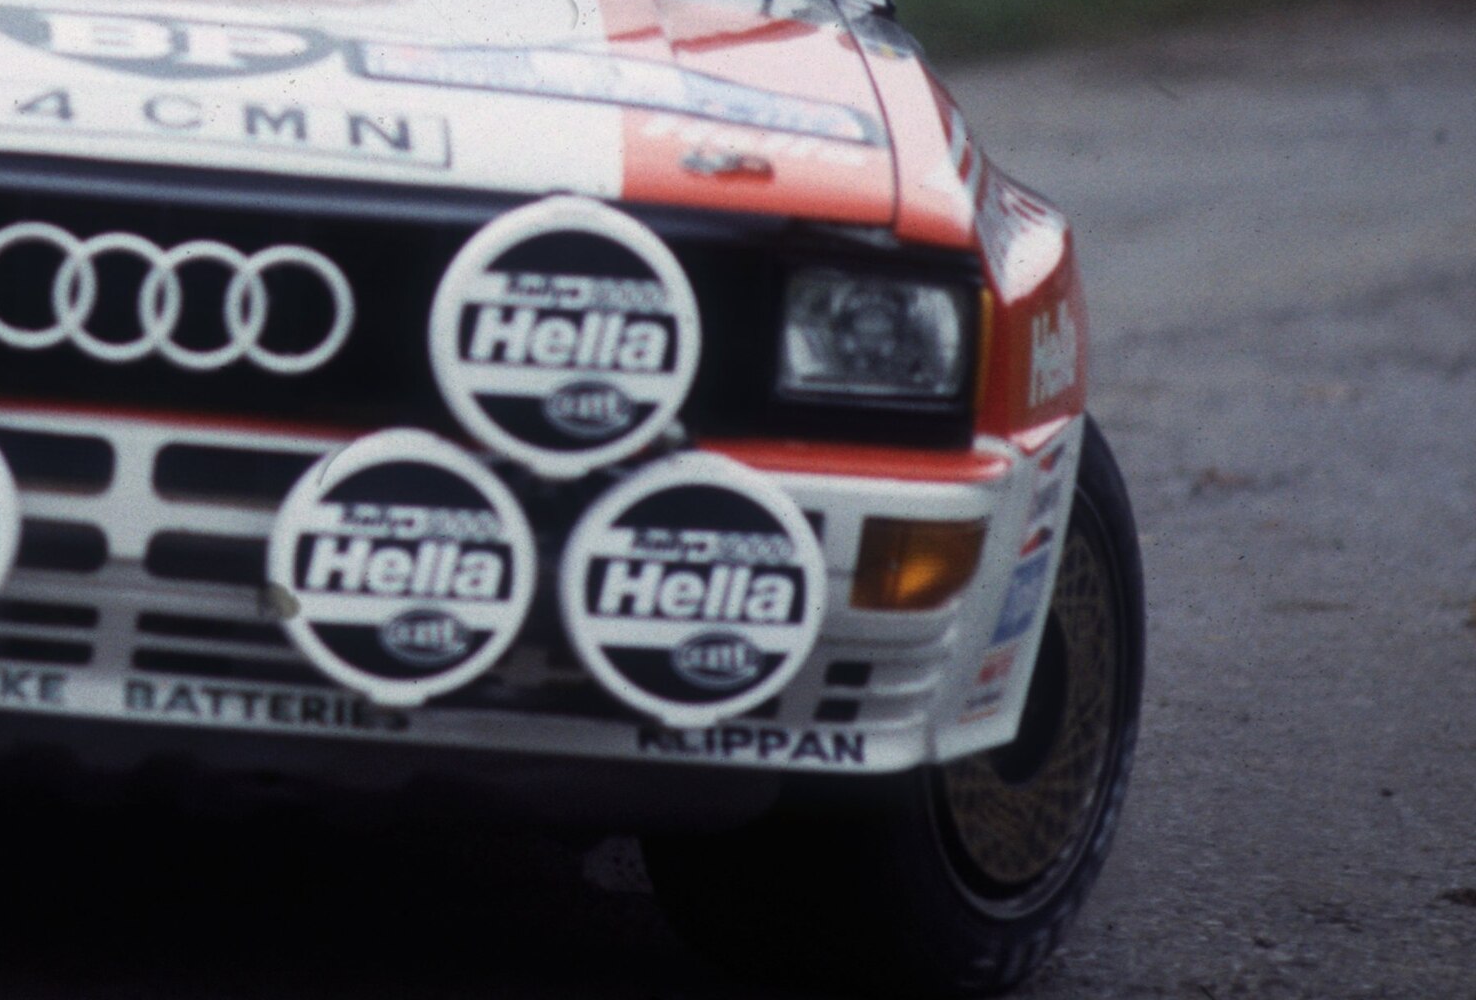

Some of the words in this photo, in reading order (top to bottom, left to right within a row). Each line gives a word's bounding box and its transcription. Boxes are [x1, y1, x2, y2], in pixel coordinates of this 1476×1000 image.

[42, 8, 311, 68] BP
[468, 307, 669, 371] Hella
[304, 534, 504, 599] Hella
[597, 558, 796, 622] Hella
[637, 722, 867, 764] KLIPPAN
